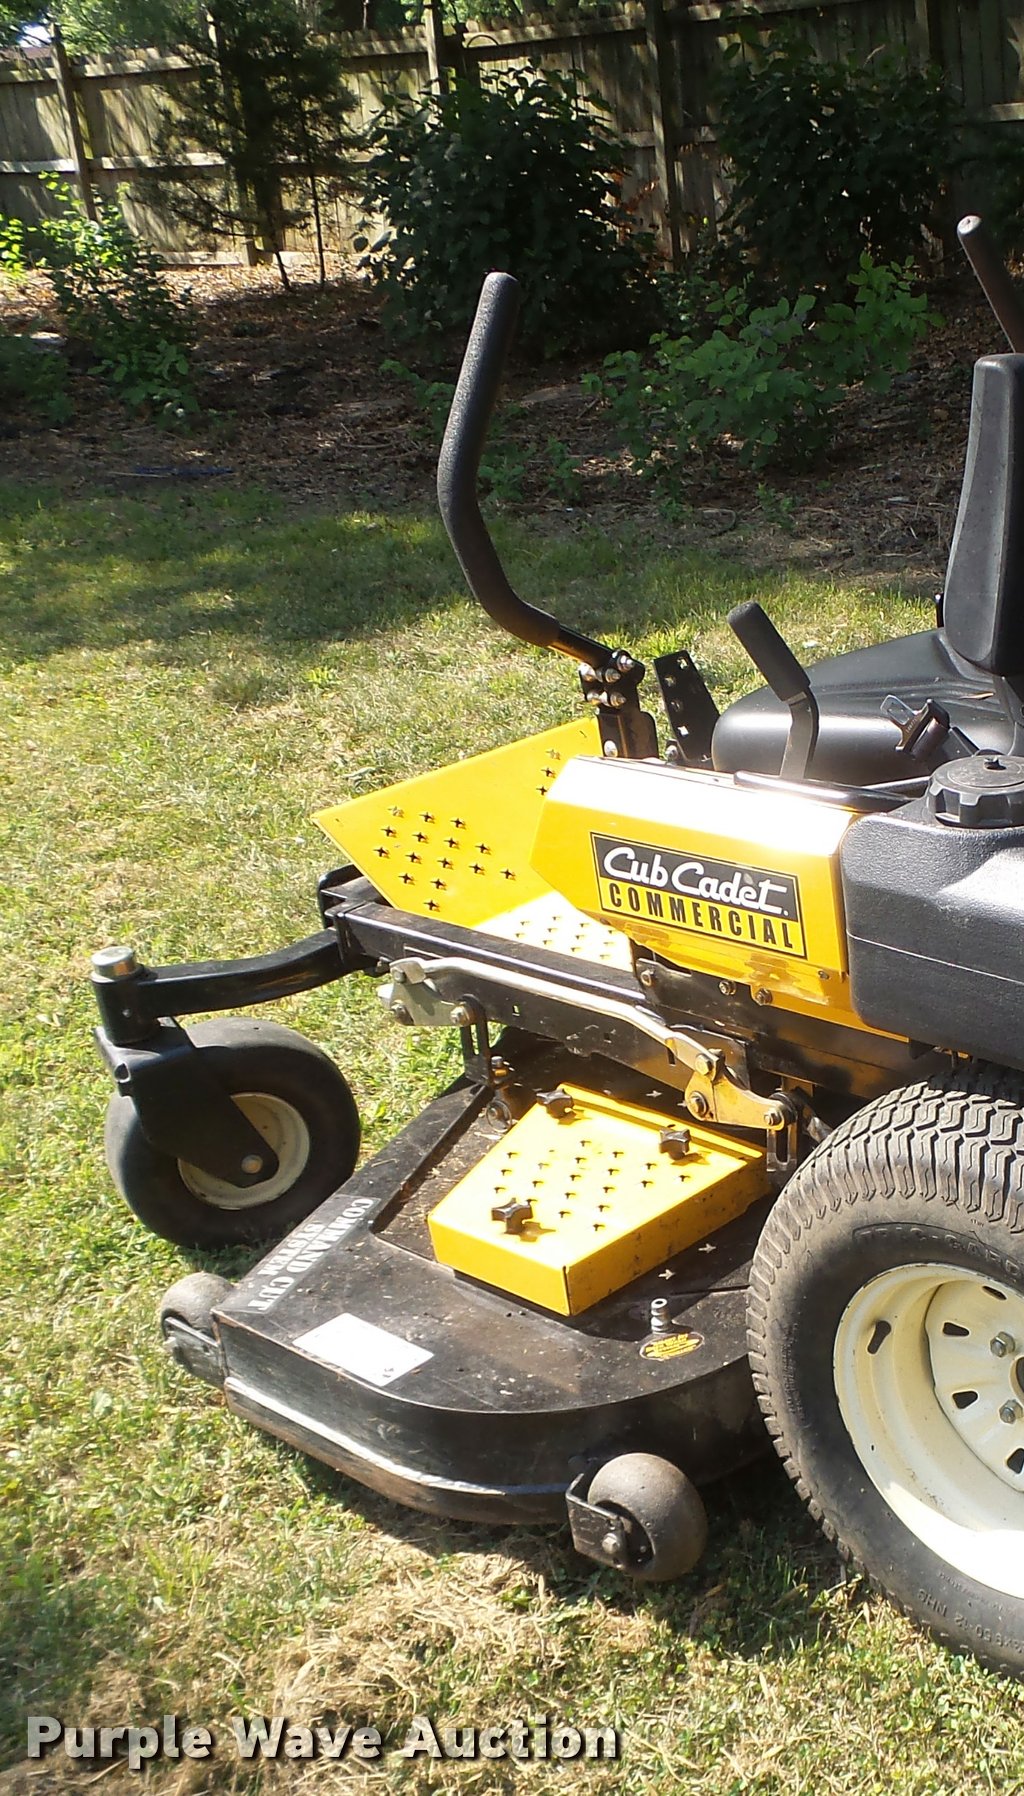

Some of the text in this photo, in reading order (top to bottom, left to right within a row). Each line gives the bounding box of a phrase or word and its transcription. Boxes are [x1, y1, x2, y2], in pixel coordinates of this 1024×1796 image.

[603, 846, 788, 914] Cub Cadet
[609, 883, 793, 949] COMMERCIAL
[248, 1198, 374, 1311] COMMAND CUT
[257, 1222, 325, 1275] SYSTEM
